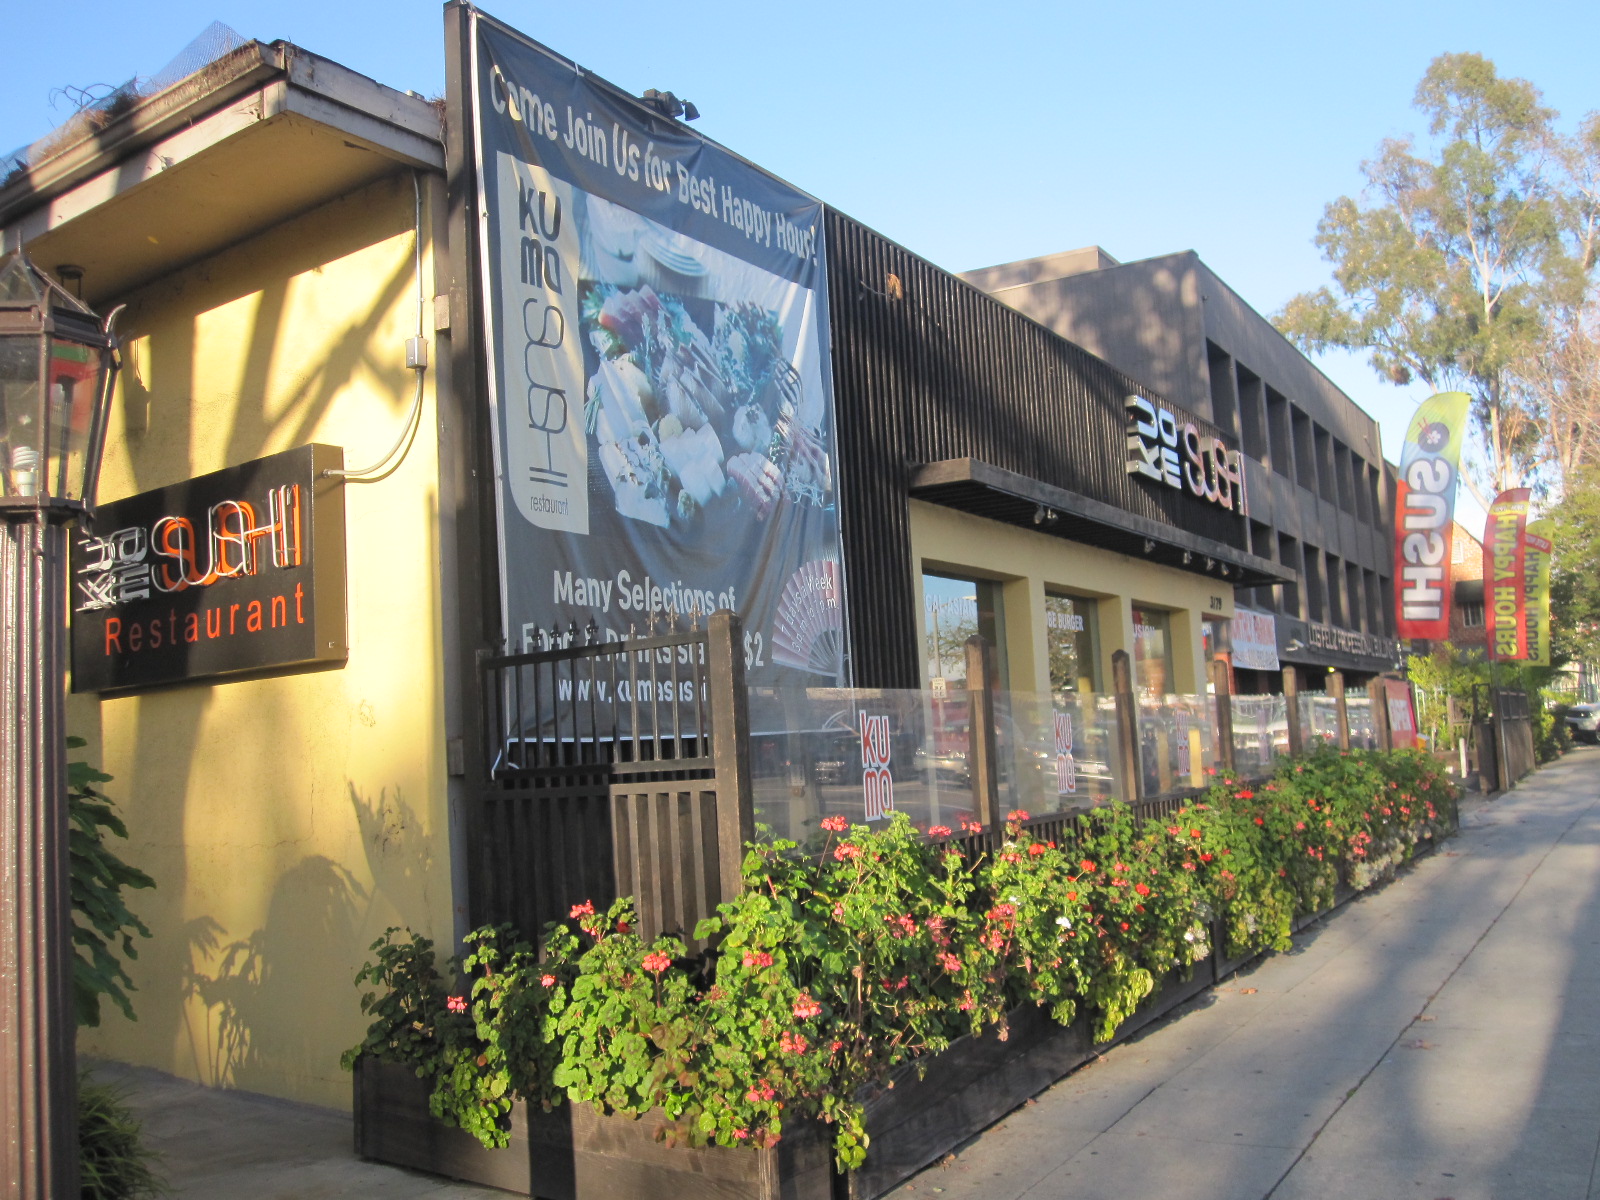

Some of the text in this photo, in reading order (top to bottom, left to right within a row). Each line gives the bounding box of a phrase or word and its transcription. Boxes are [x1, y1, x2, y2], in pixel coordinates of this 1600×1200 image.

[490, 64, 817, 267] Come Join Us for Best Happy Hour!
[1181, 422, 1248, 517] SUSHI
[530, 494, 569, 516] restaurant
[151, 483, 301, 593] SUSHI
[553, 569, 735, 616] Many Selections of
[806, 573, 833, 593] Week
[1210, 595, 1222, 611] 3179
[105, 582, 304, 656] Restaurant
[1058, 613, 1084, 632] BURGER
[1133, 622, 1155, 639] USION
[744, 630, 764, 671] $2
